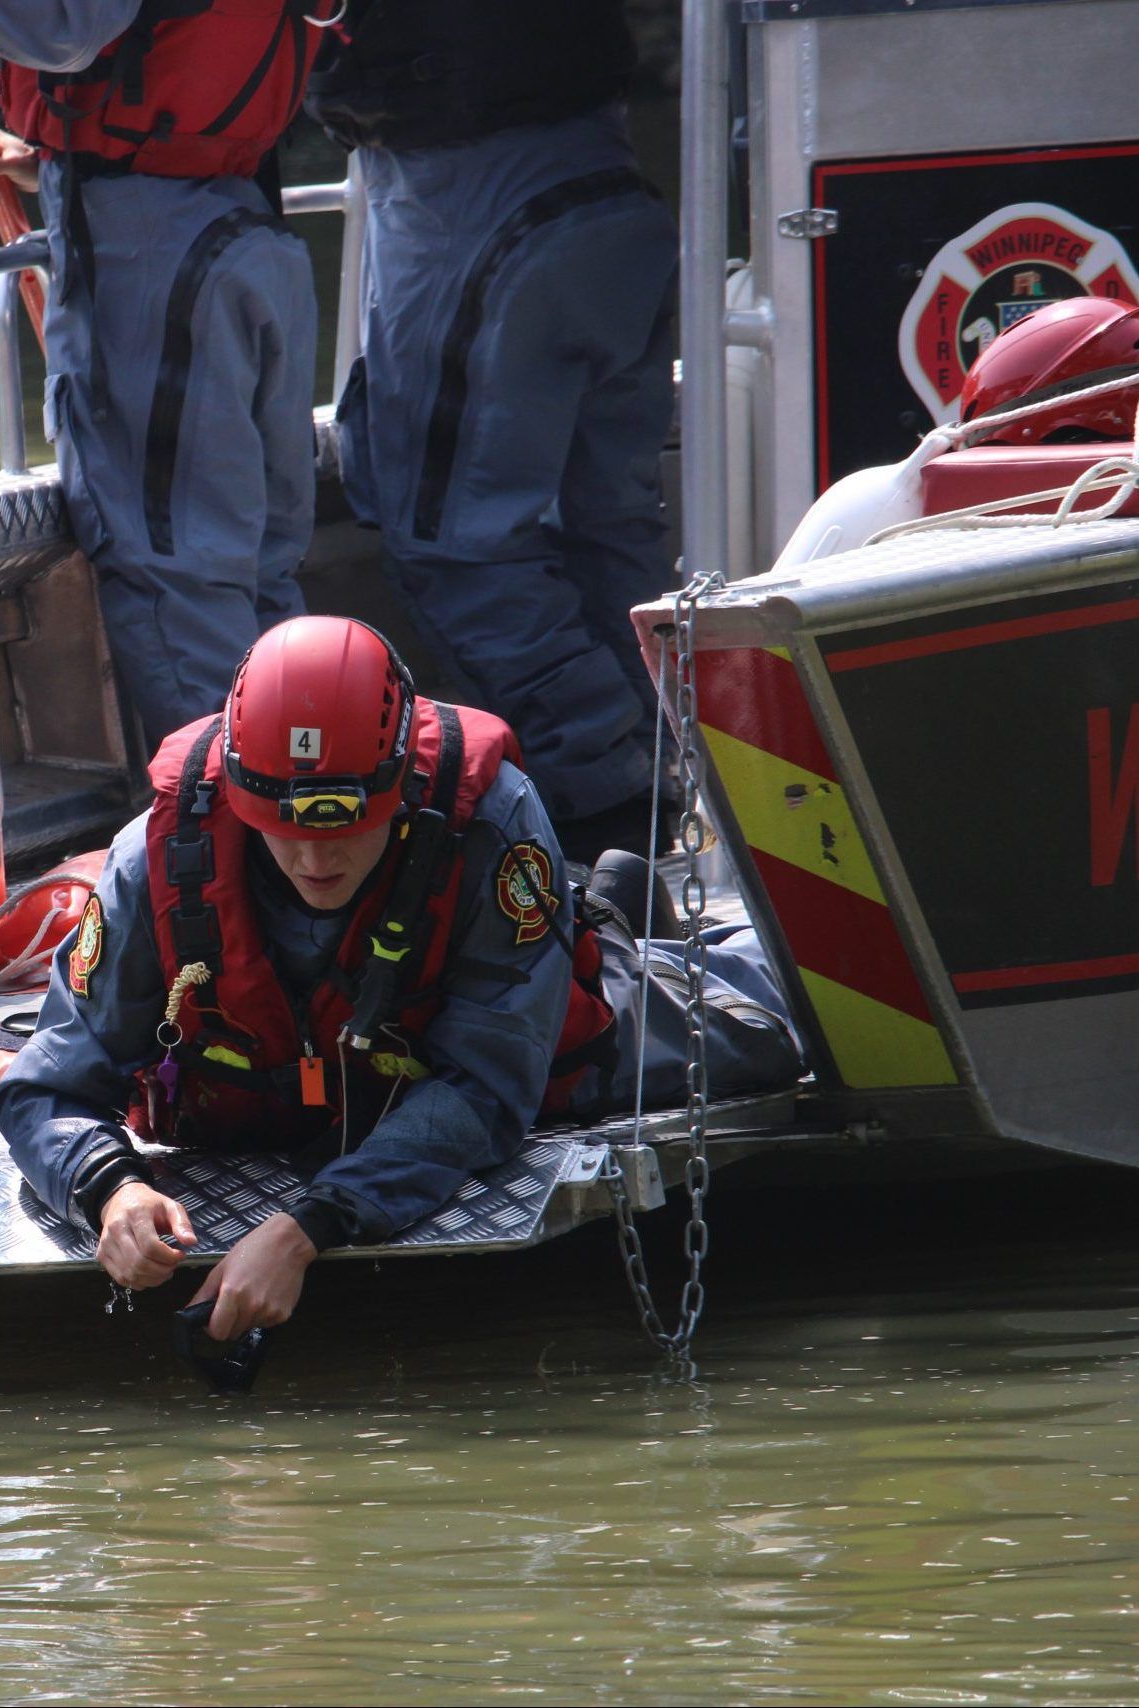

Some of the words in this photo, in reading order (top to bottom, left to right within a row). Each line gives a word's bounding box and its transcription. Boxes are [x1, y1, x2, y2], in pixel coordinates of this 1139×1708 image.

[972, 233, 1084, 268] WINNIPEG
[937, 293, 951, 389] FIRE
[298, 731, 311, 753] 4
